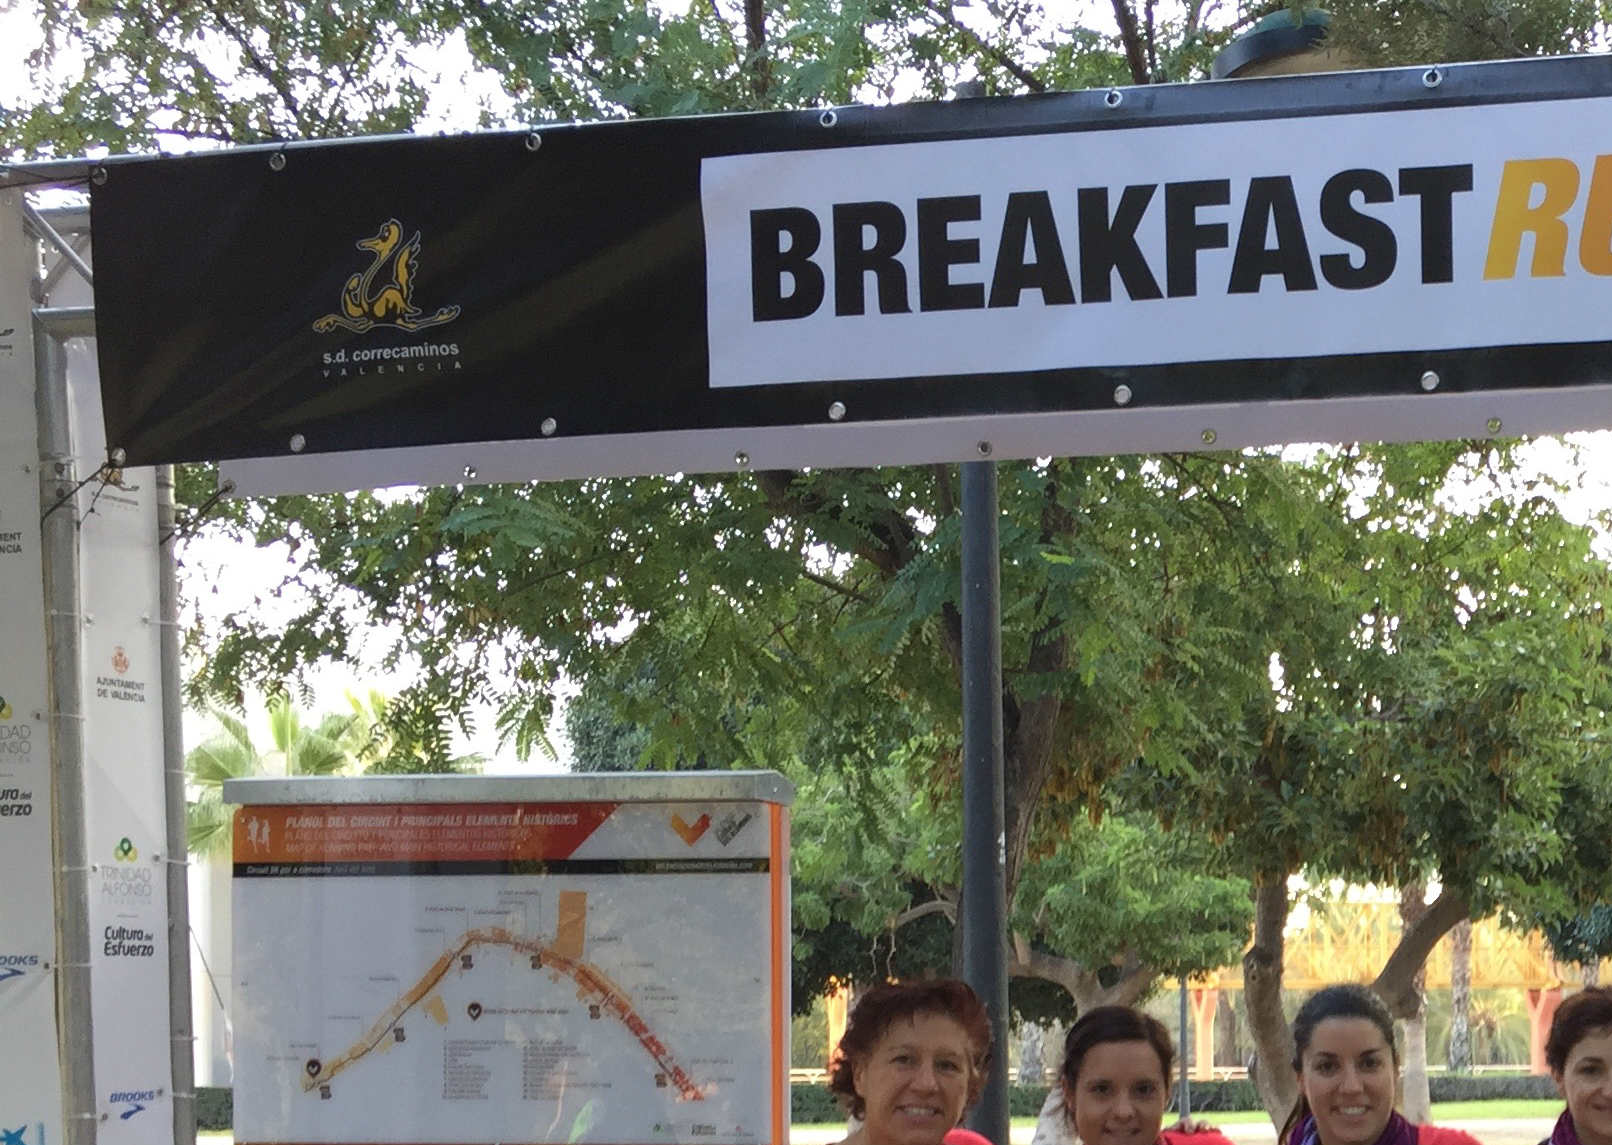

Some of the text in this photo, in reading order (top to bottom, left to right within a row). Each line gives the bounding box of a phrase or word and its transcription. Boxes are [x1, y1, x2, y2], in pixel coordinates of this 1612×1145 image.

[750, 163, 1474, 323] BREAKFAST
[322, 341, 461, 365] s.d. correcaminos
[322, 360, 463, 379] VALENCIA
[104, 926, 144, 941] Cultura
[103, 940, 154, 957] Esfuerzo
